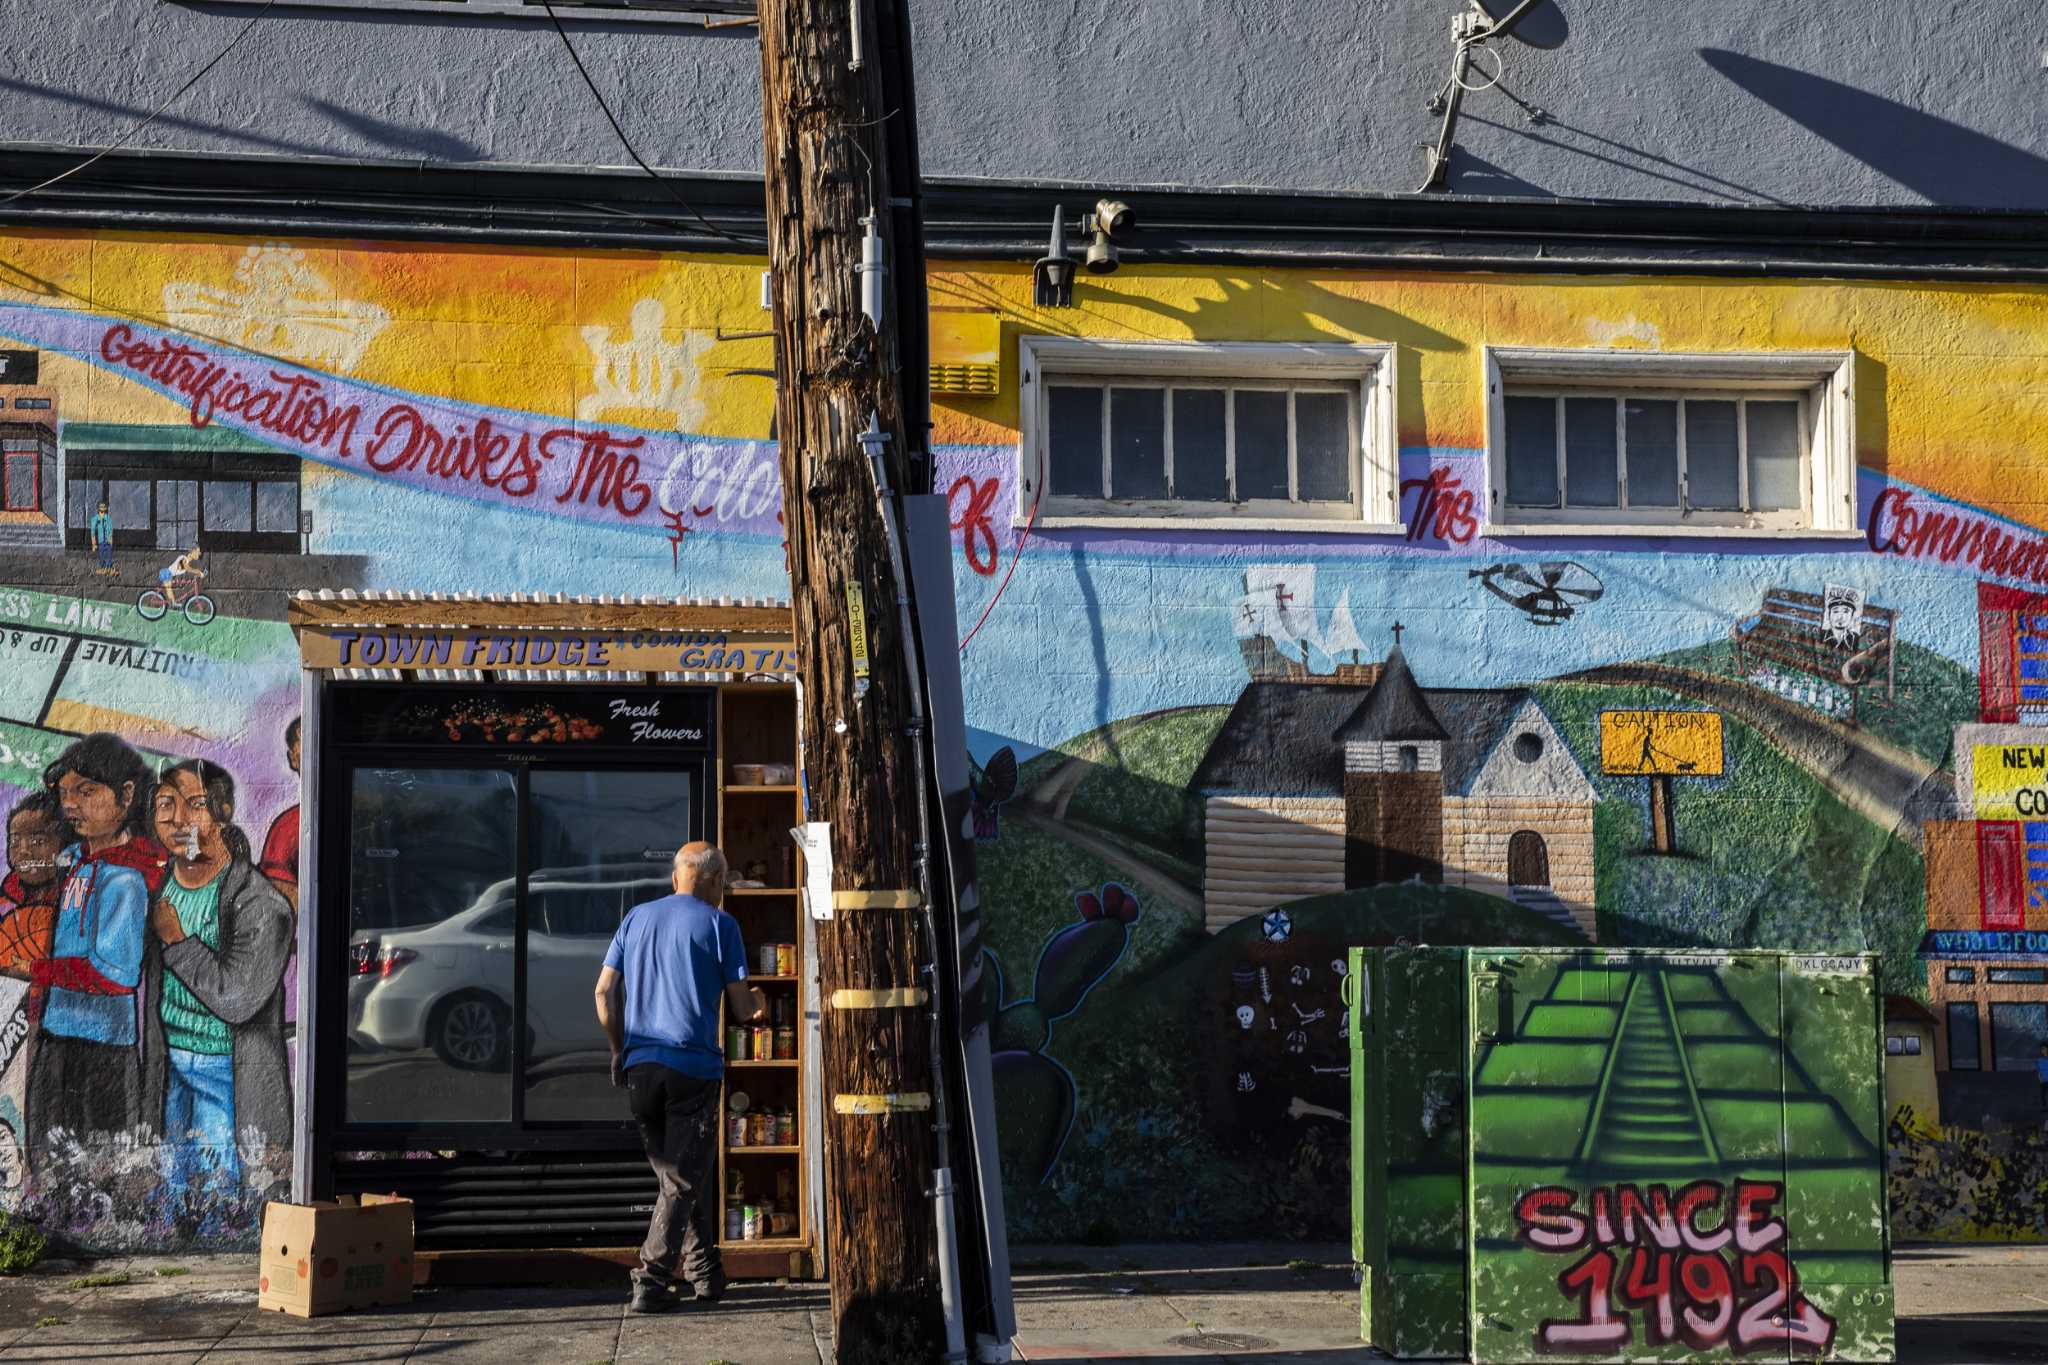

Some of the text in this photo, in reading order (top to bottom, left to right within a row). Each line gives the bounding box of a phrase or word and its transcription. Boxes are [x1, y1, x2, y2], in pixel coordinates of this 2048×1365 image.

[365, 403, 542, 497] Drives
[538, 429, 653, 517] The
[1401, 465, 1479, 545] The
[45, 598, 114, 632] LANE
[330, 631, 612, 666] TOWN FRIDGE
[630, 631, 728, 648] COMIDA
[608, 699, 661, 720] Fresh
[1613, 711, 1707, 731] CAUTION
[629, 720, 703, 743] Flowers
[2002, 748, 2045, 769] NEW
[1517, 1178, 1788, 1252] SINCE
[1538, 1248, 1836, 1352] 1492
